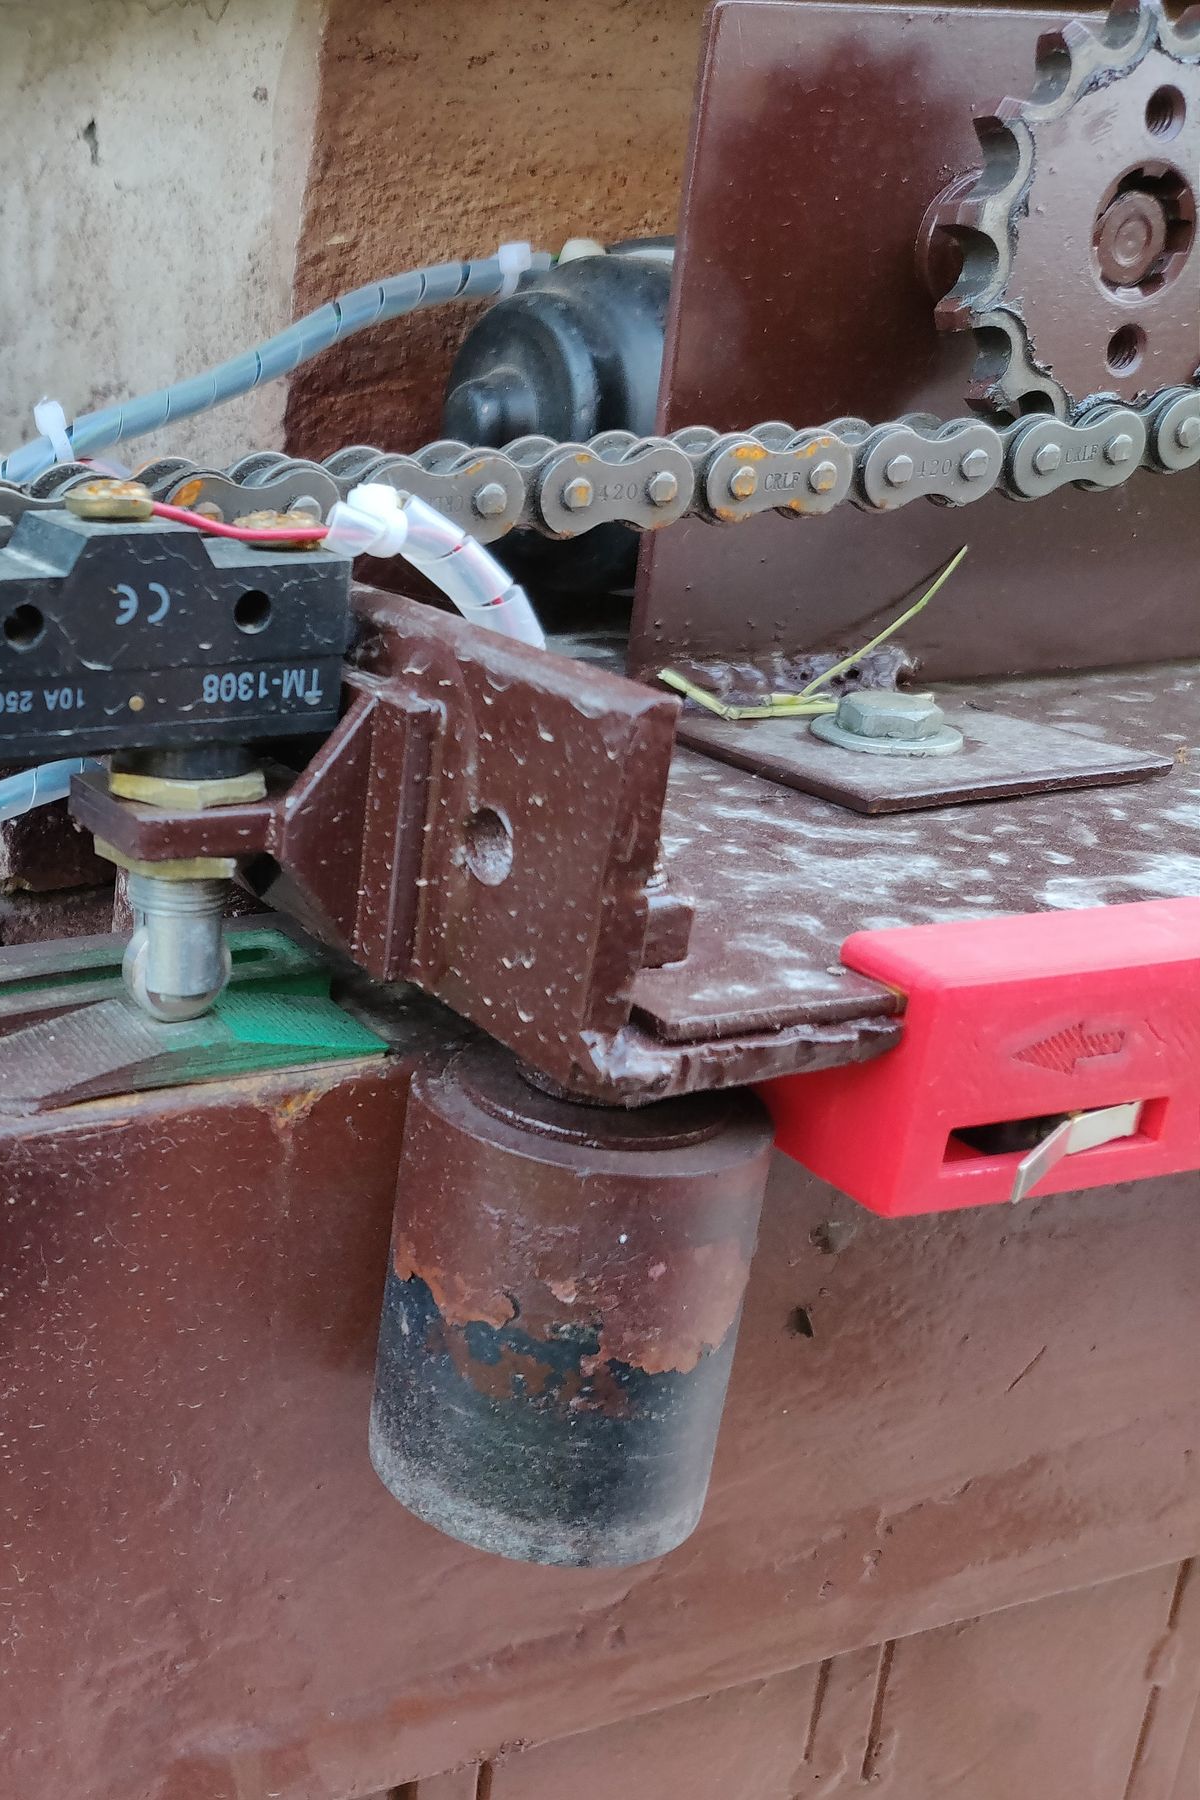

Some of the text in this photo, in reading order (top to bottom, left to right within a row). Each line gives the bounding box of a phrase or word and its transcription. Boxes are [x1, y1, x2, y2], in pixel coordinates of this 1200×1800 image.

[597, 483, 638, 501] 420
[115, 582, 171, 625] CE
[43, 687, 86, 711] 10A
[202, 668, 323, 704] TM-1308
